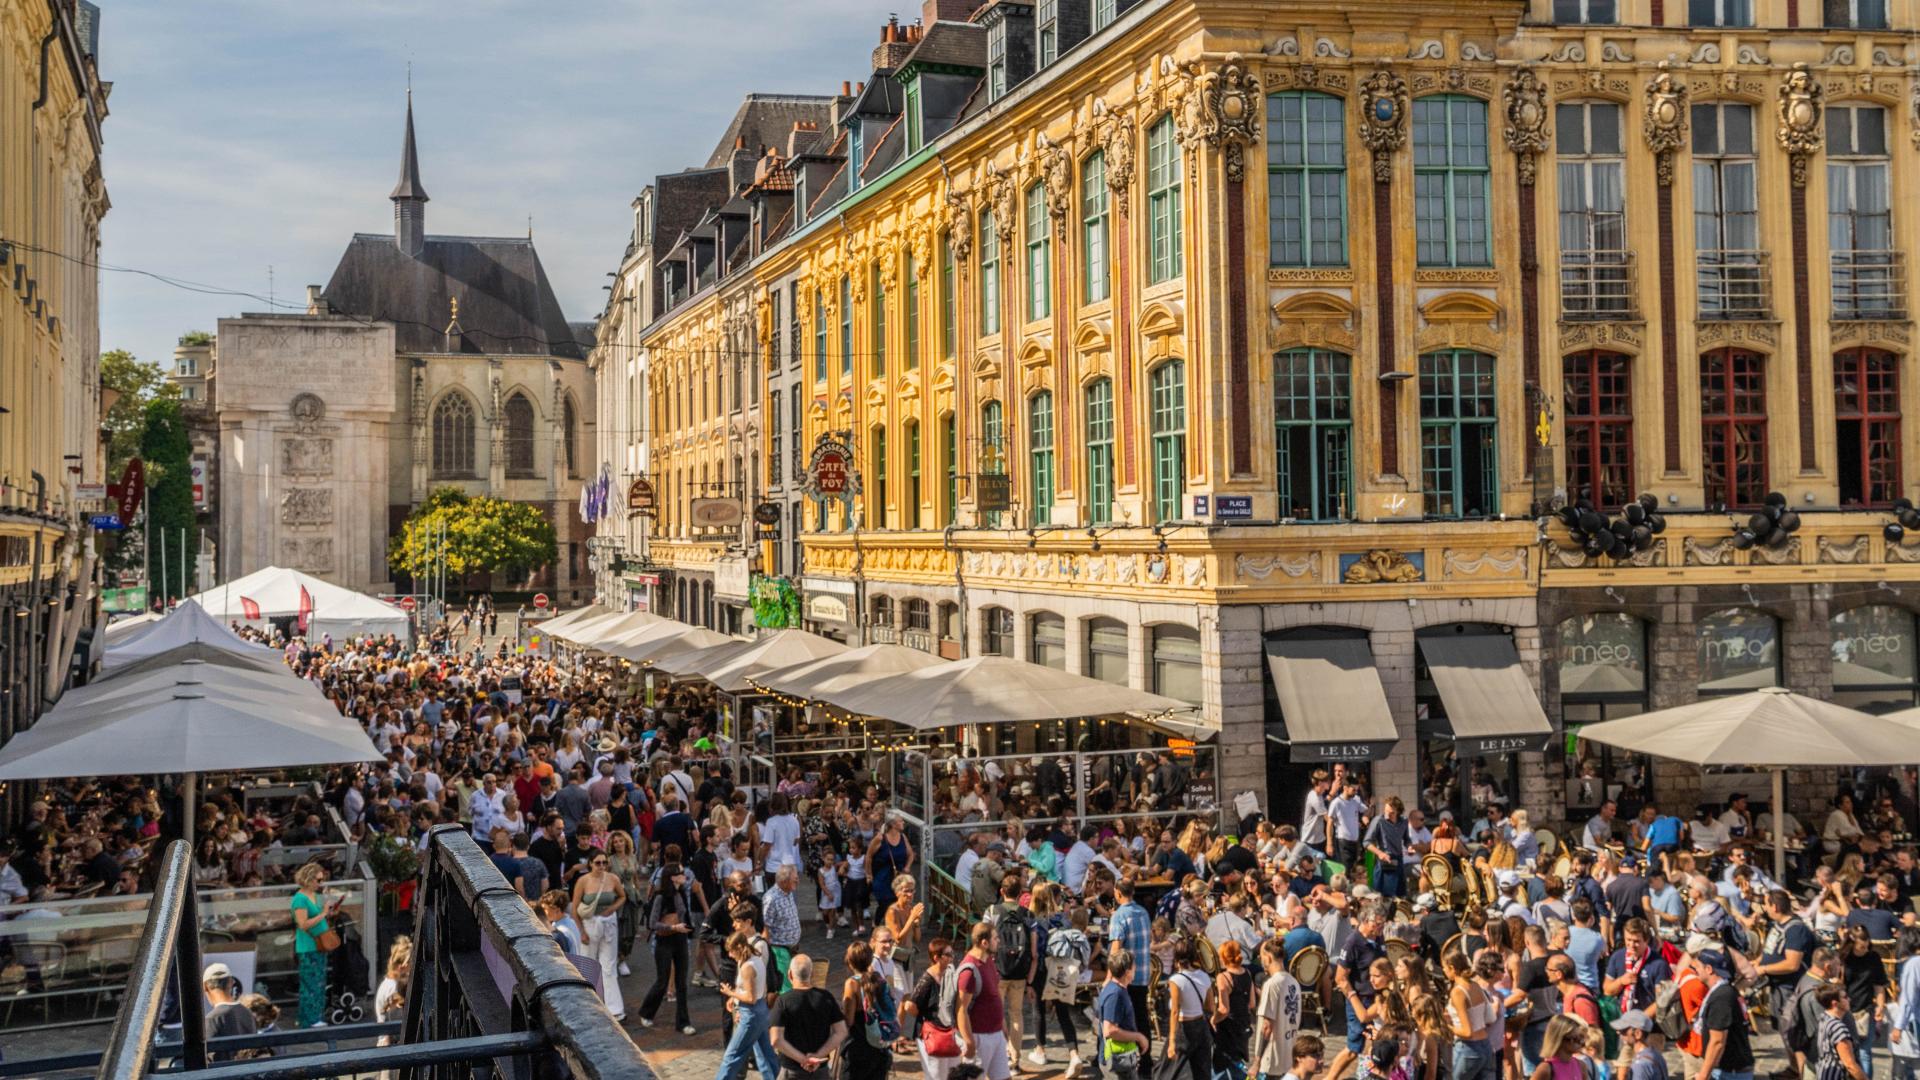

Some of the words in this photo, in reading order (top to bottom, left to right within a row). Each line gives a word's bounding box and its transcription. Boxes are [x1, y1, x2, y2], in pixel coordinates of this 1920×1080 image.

[814, 443, 851, 460] BRASSERIE
[821, 479, 843, 488] FOY
[992, 479, 1009, 489] LYS
[124, 471, 138, 512] TABAC
[1480, 740, 1498, 750] LE
[1500, 738, 1527, 748] LYS
[1320, 746, 1339, 756] LE
[1342, 745, 1370, 755] LYS
[1191, 785, 1207, 793] Salle
